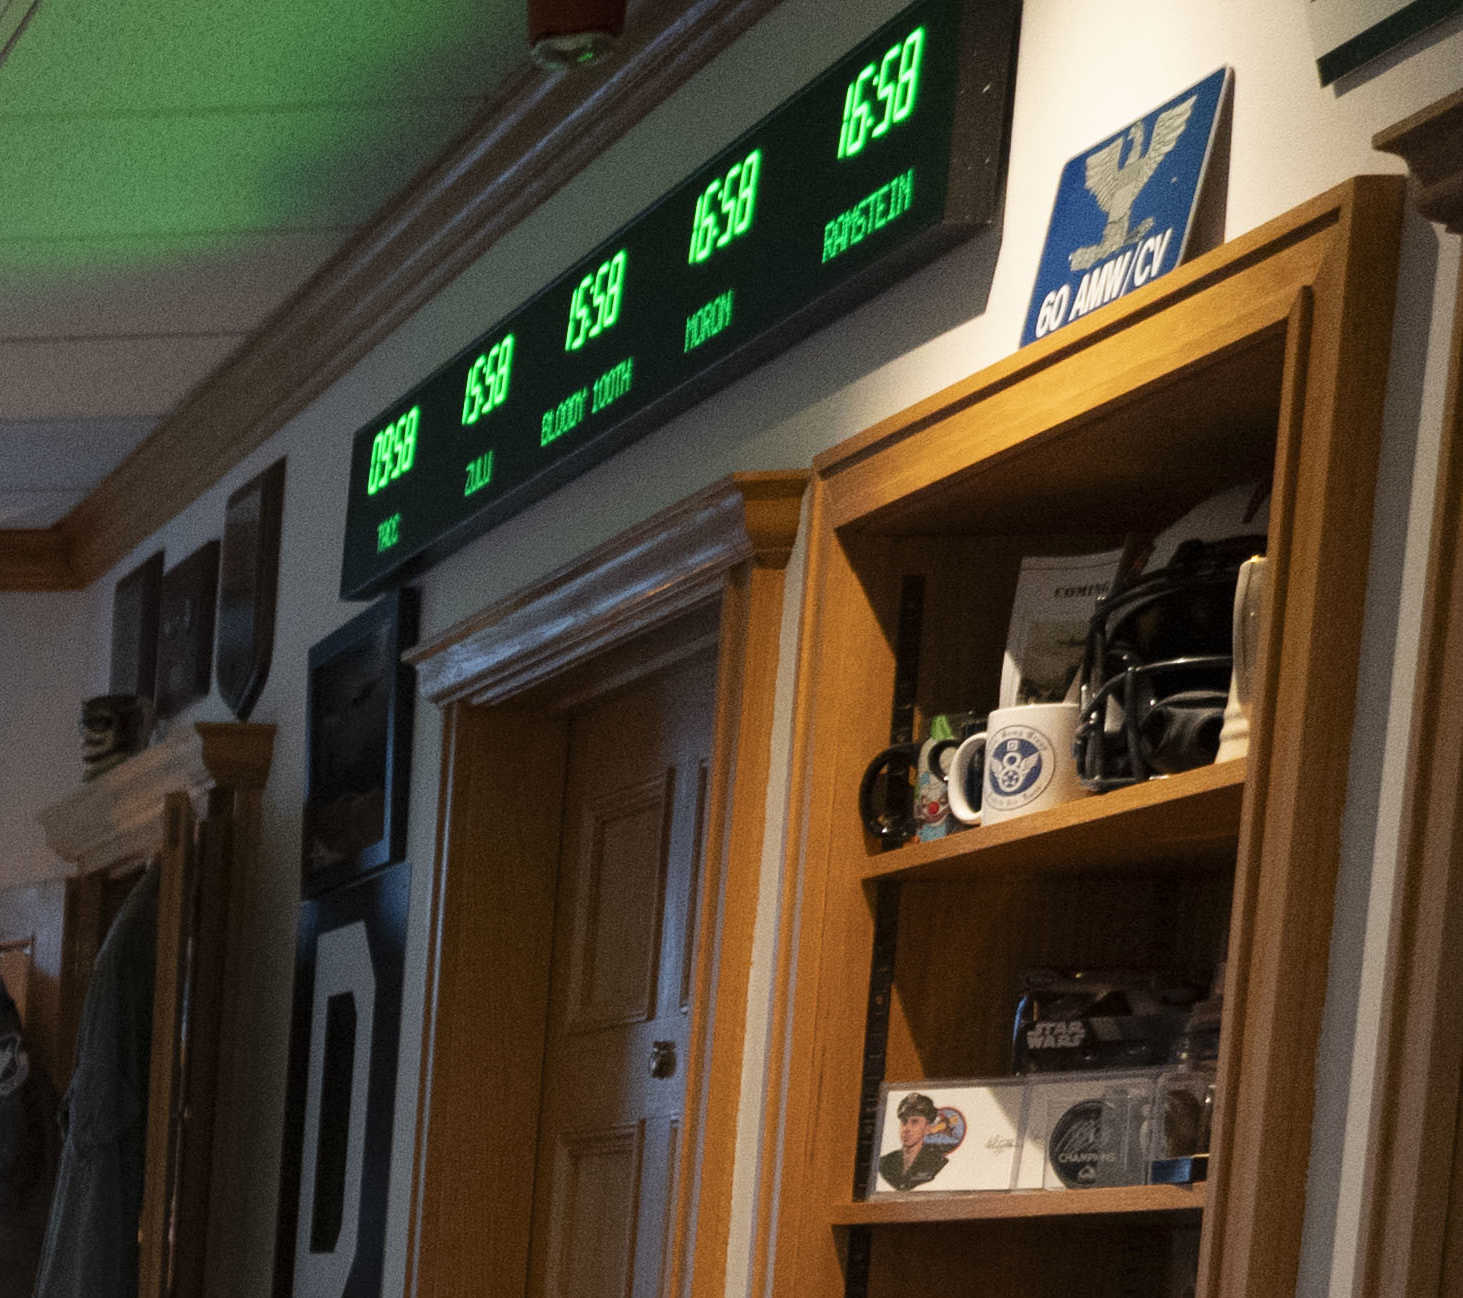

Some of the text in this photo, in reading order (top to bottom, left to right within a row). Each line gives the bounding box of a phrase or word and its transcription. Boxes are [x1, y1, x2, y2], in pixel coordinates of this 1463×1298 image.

[837, 25, 926, 160] 16:58
[688, 147, 762, 264] 16:58
[822, 168, 914, 264] RAMSTEIN
[565, 248, 627, 351] 15:58
[684, 288, 734, 353] MORON
[1035, 228, 1172, 338] 60 AMW/CV
[462, 331, 514, 426] 15:58
[540, 356, 634, 447] BLOODY 100TH
[368, 405, 420, 496] 09:58
[464, 451, 493, 497] ZULU
[1027, 1020, 1085, 1036] STAR
[1027, 1033, 1086, 1049] WARS
